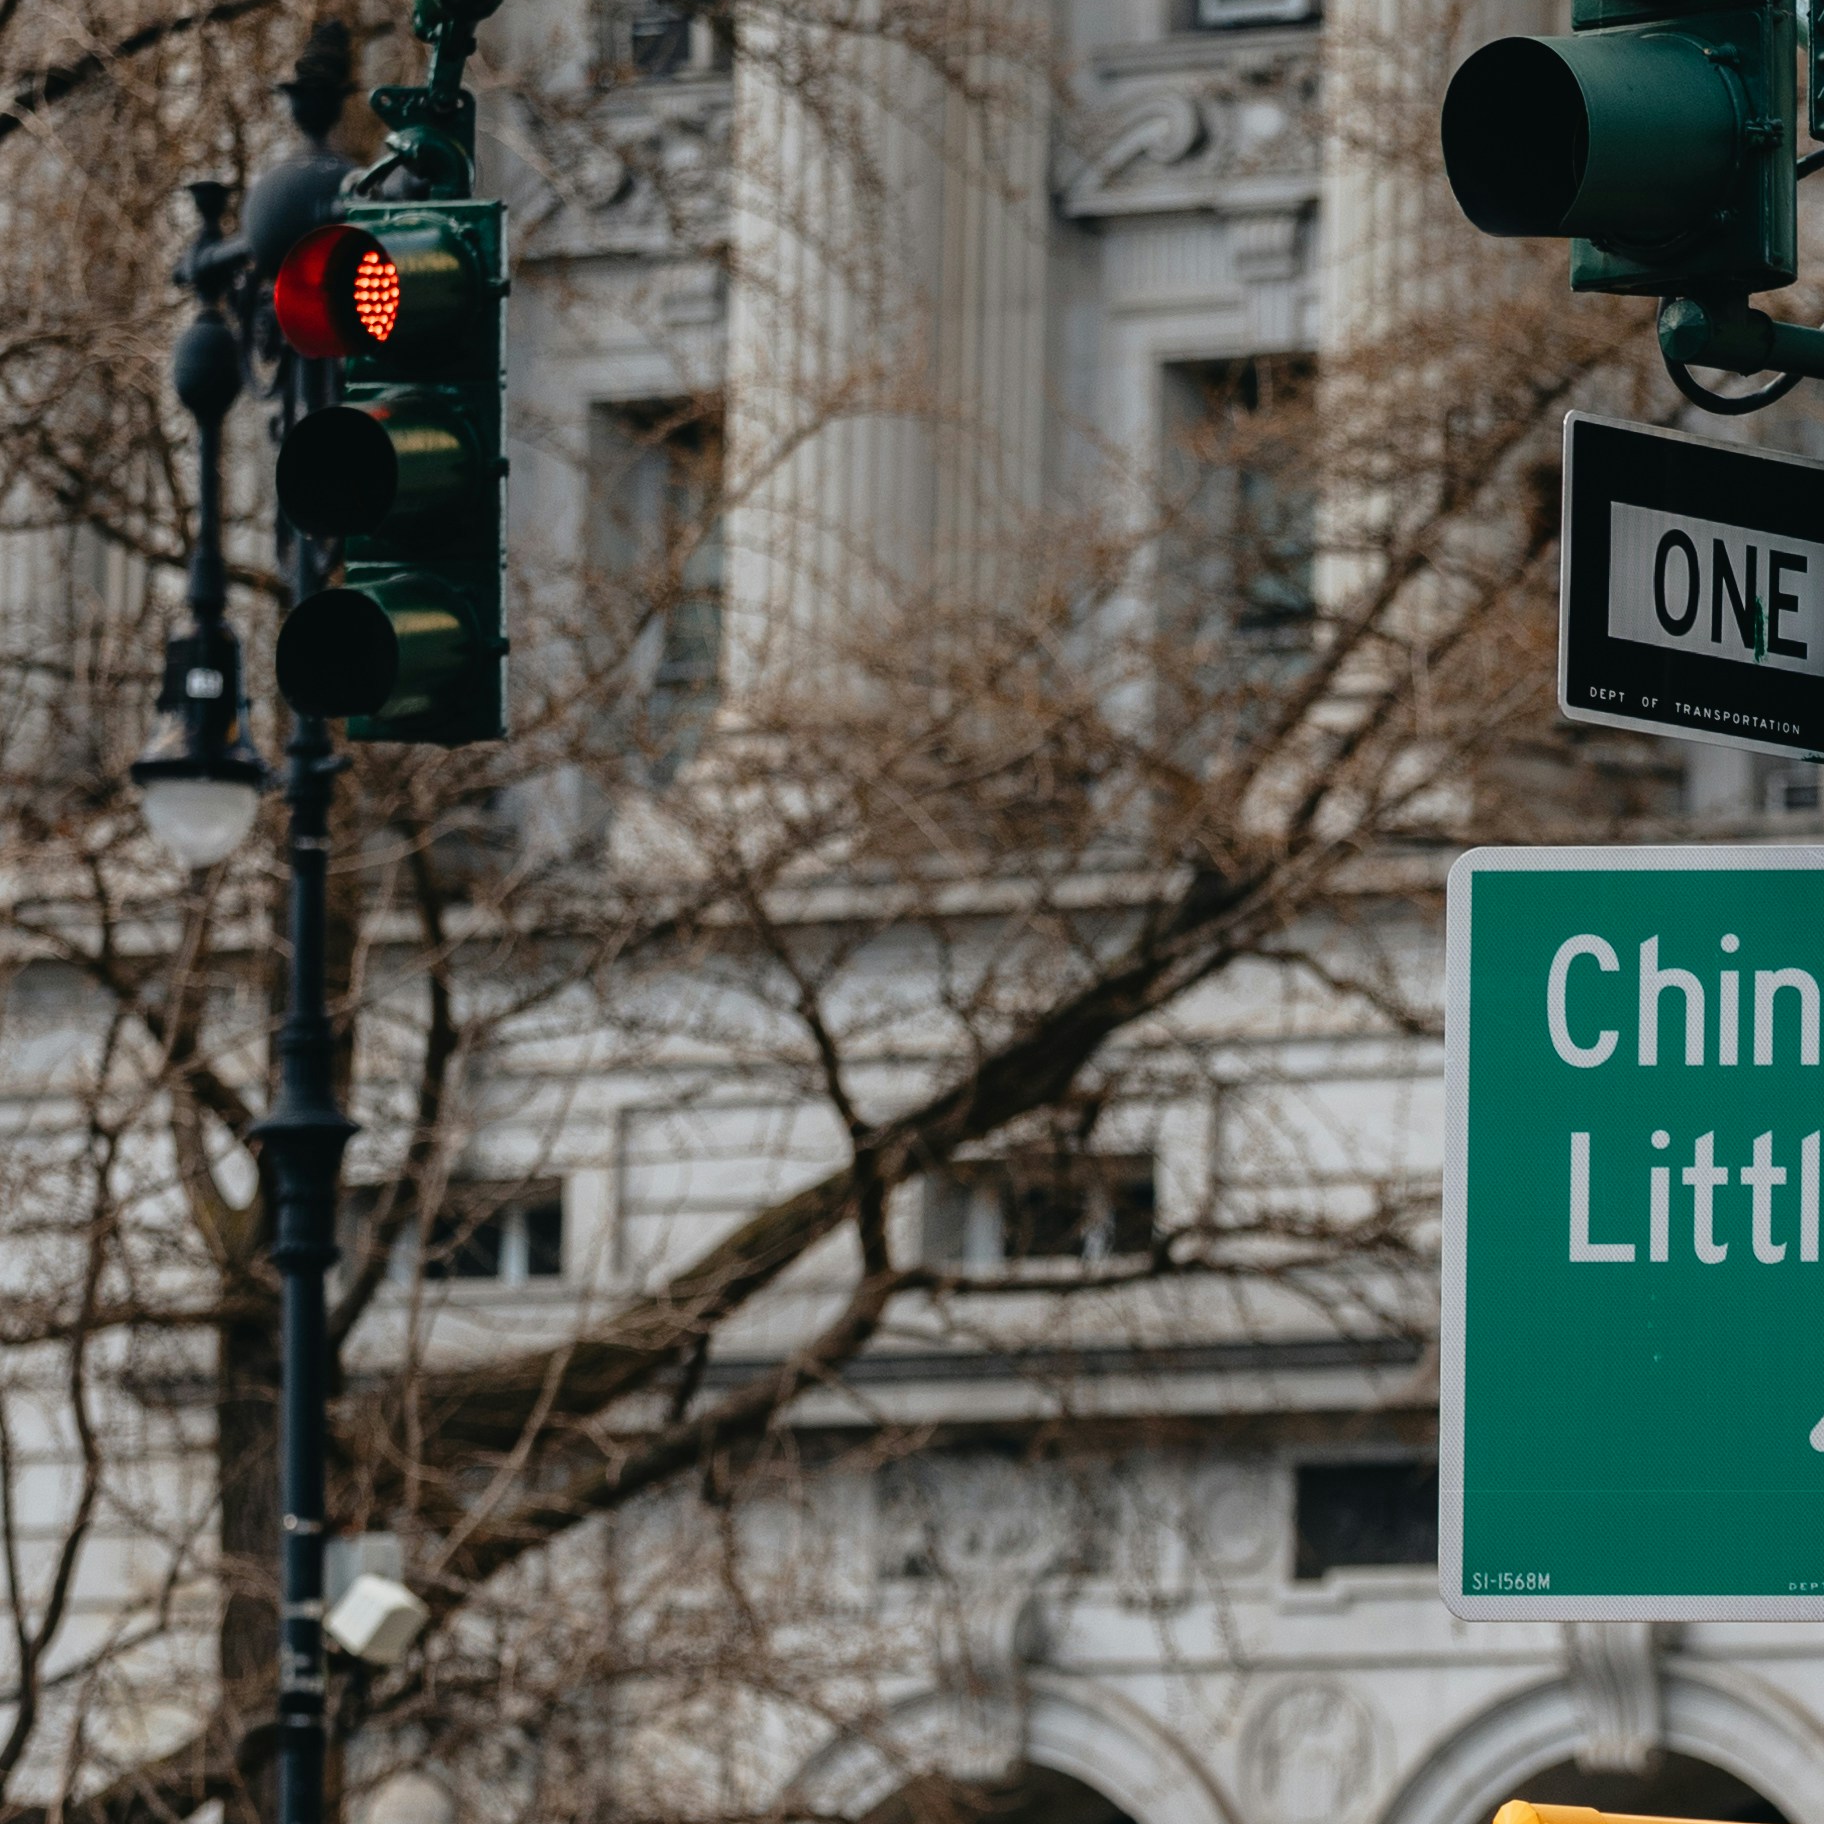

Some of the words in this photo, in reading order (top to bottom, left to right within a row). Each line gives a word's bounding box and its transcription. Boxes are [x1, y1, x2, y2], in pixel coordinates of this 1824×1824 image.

[1652, 526, 1810, 661] ONE
[1589, 686, 1625, 703] DEPT
[1641, 696, 1658, 709] OF
[1675, 702, 1801, 736] TRANSPORTATION
